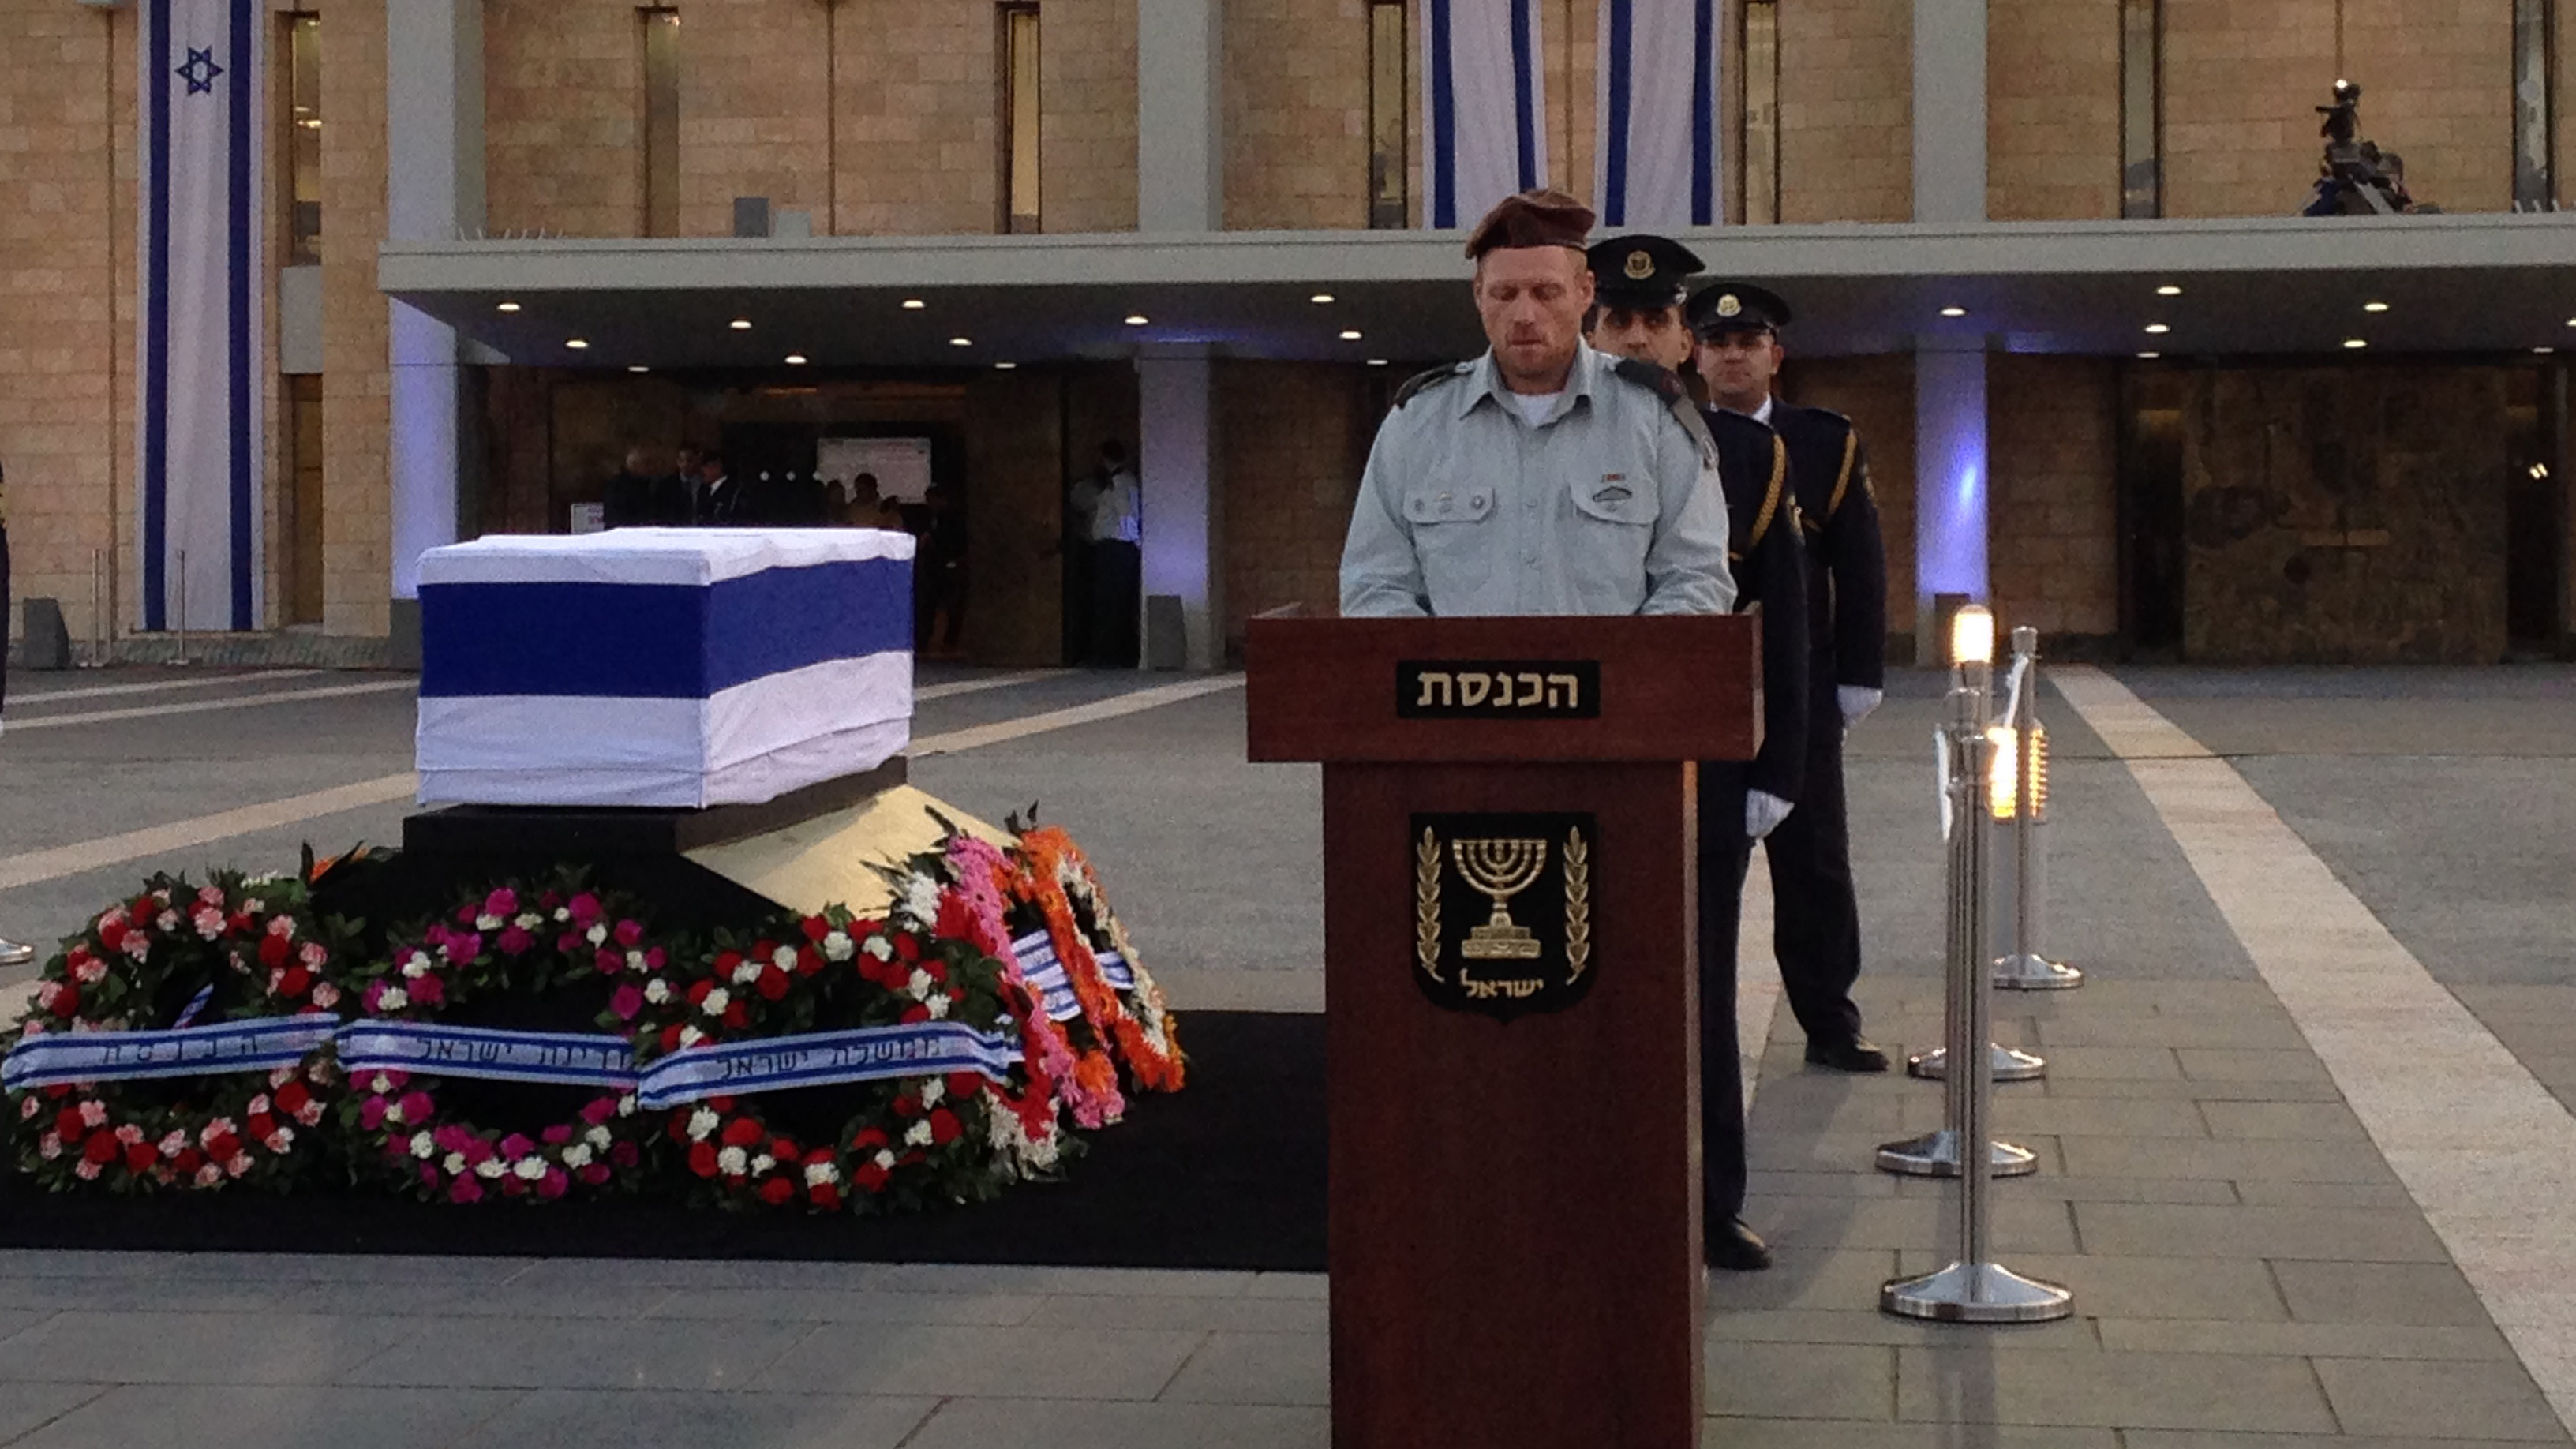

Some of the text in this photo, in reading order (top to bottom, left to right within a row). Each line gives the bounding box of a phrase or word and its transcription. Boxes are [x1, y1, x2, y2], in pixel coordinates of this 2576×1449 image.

[1417, 672, 1578, 708] הכנסת
[1460, 968, 1544, 998] ישראל
[417, 1035, 513, 1062] ישראל
[717, 1051, 809, 1080] ישראל
